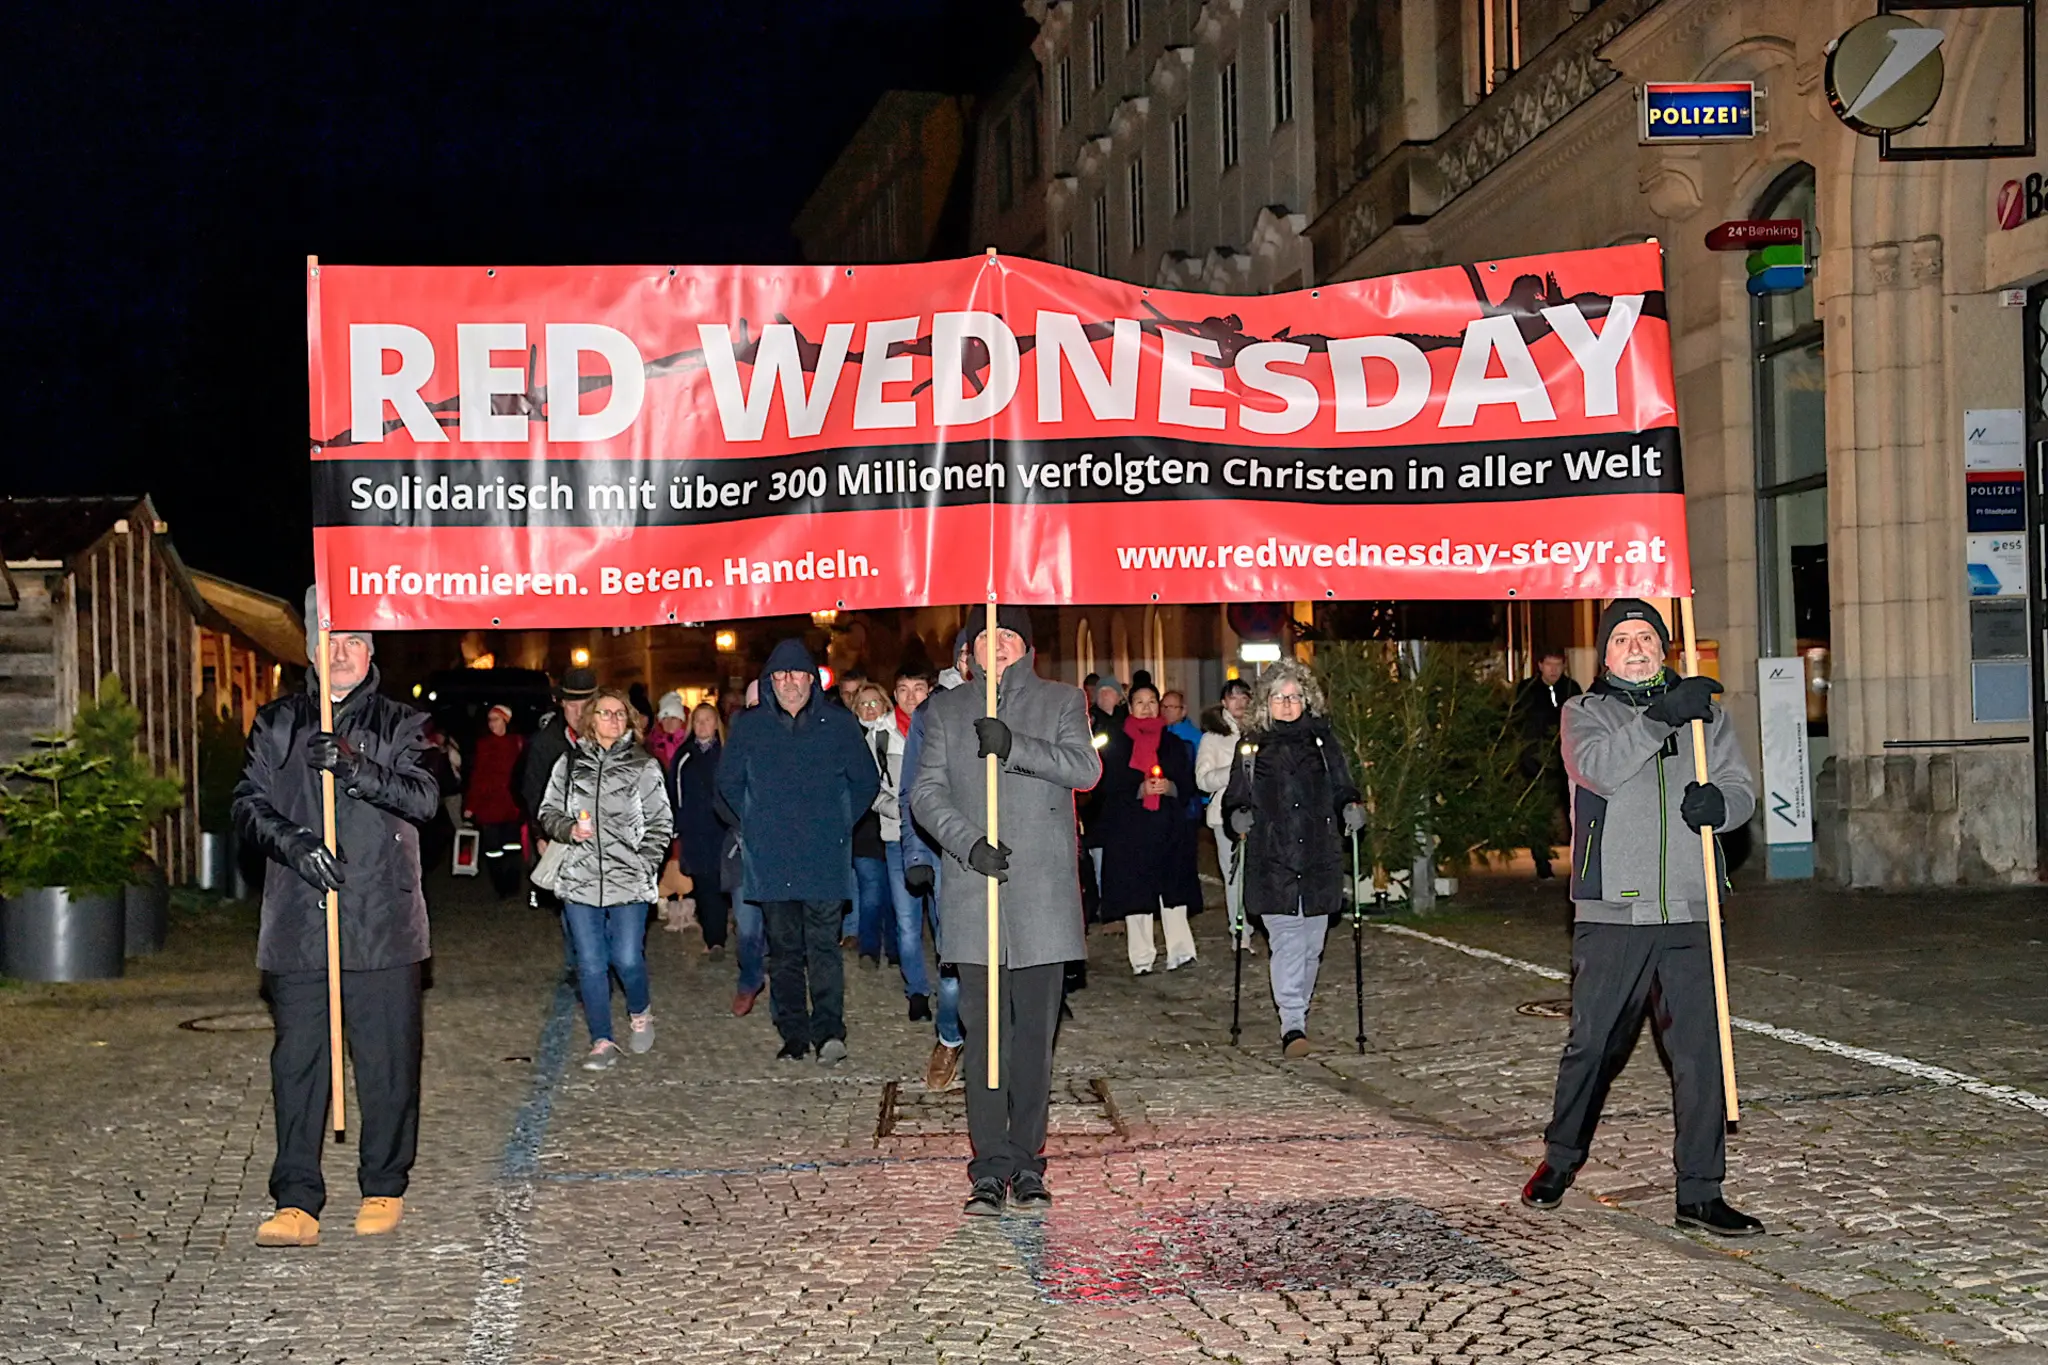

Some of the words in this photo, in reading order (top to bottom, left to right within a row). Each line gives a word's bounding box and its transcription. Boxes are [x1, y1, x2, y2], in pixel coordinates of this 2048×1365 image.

[1649, 107, 1738, 124] POLIZEI
[2025, 172, 2048, 219] B
[1748, 225, 1799, 239] B@nking
[349, 323, 646, 443] RED
[697, 294, 1645, 442] WEDNESDAY
[350, 476, 574, 511] Solidarisch
[587, 477, 657, 510] mit
[669, 475, 758, 510] über
[768, 466, 827, 501] 300
[838, 459, 1005, 495] Millionen
[1017, 452, 1209, 495] verfolgten
[1222, 458, 1394, 492] Christen
[1408, 459, 1445, 489] in
[1457, 455, 1553, 488] aller
[1563, 445, 1663, 482] Welt
[1970, 486, 2015, 496] POLIZEI
[349, 564, 589, 596] Informieren.
[601, 565, 713, 596] Beten.
[723, 549, 880, 588] Handeln.
[1116, 535, 1666, 574] www.redwednesday-steyr.at
